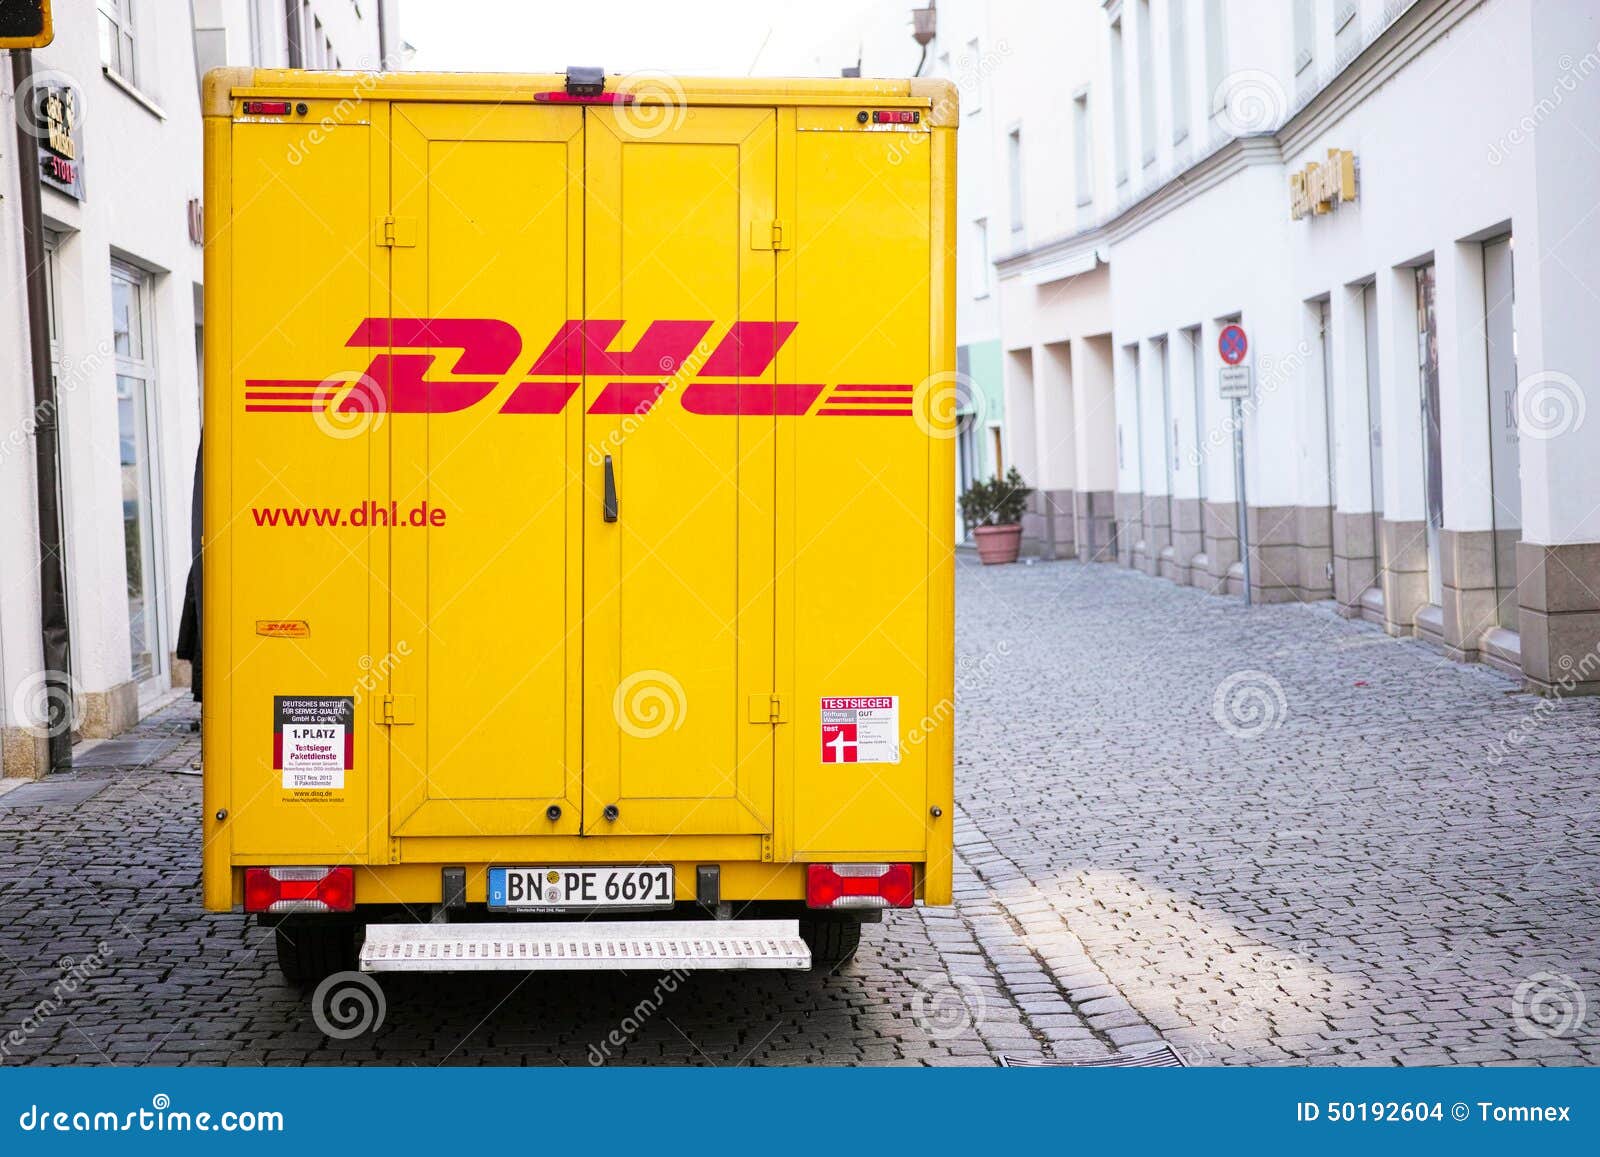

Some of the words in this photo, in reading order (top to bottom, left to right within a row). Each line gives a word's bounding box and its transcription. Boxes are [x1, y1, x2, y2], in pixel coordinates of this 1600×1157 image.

[335, 317, 826, 416] DHL
[251, 500, 447, 527] www.dhl.de
[822, 698, 891, 708] TESTSIEGER
[282, 707, 294, 715] FÜR
[302, 729, 336, 739] PLATZ
[295, 744, 332, 753] Testsieger
[290, 752, 337, 760] Paketdienste
[507, 872, 543, 901] BN
[564, 872, 598, 901] PE
[604, 871, 671, 901] 6691
